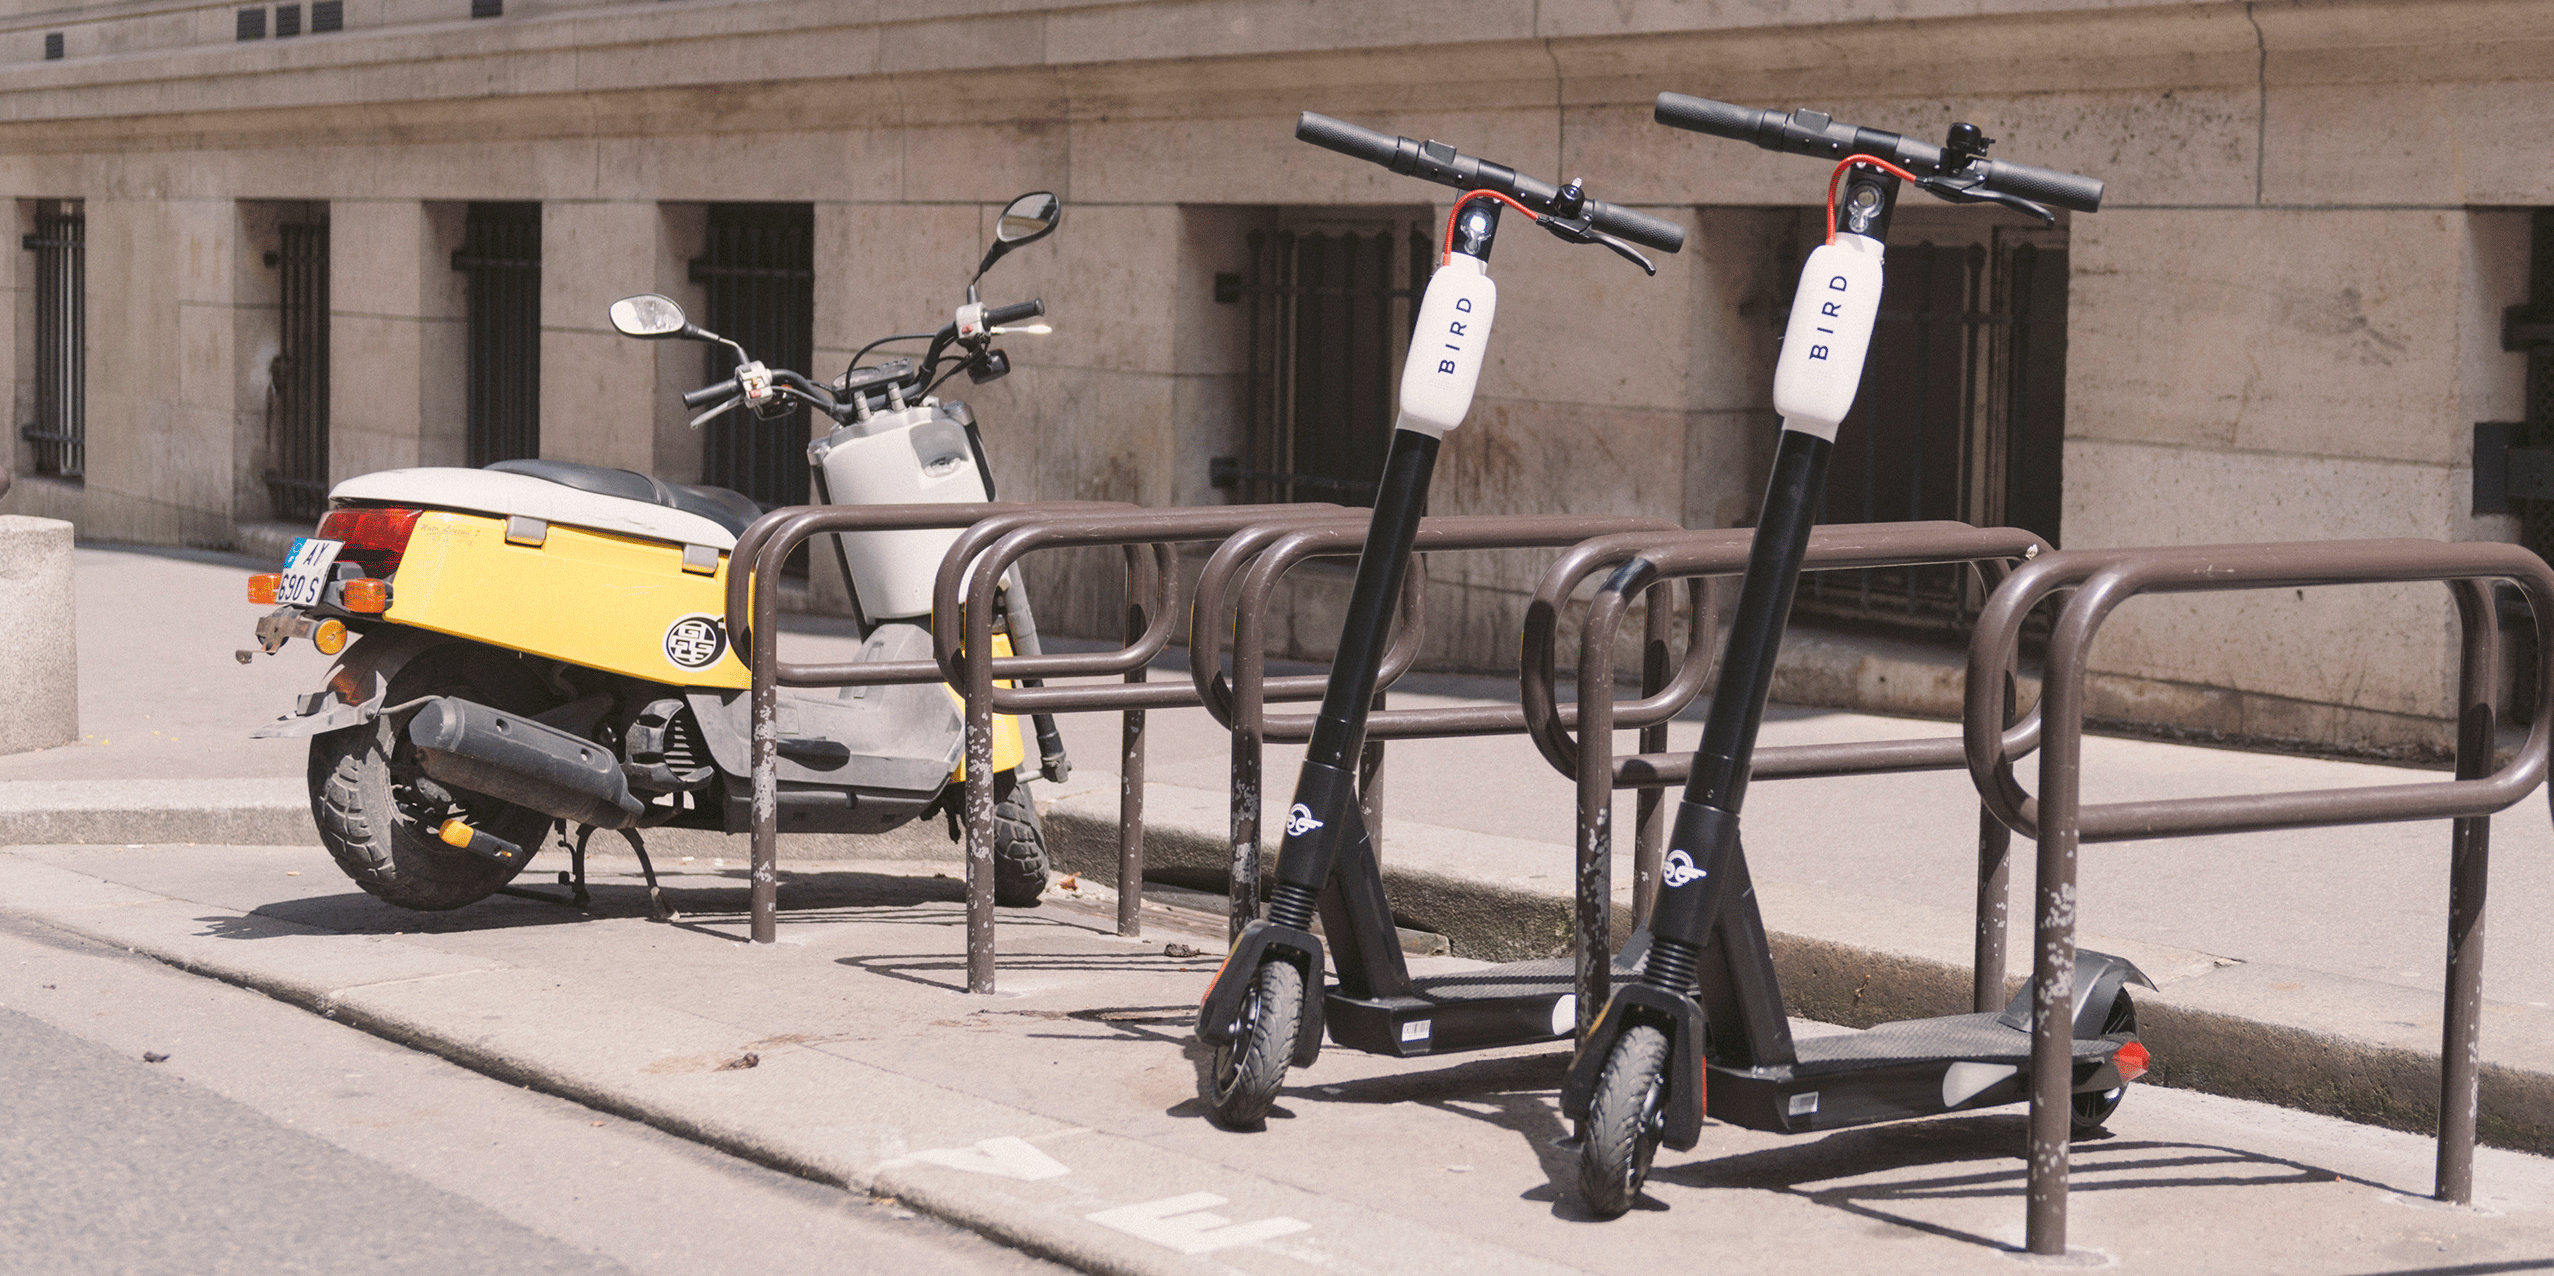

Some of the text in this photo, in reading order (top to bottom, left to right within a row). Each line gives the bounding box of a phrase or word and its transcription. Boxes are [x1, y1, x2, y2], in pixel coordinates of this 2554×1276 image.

[1437, 298, 1472, 375] BIRD
[1809, 275, 1847, 361] BIRD
[302, 542, 331, 567] AY
[278, 573, 320, 603] 690 S
